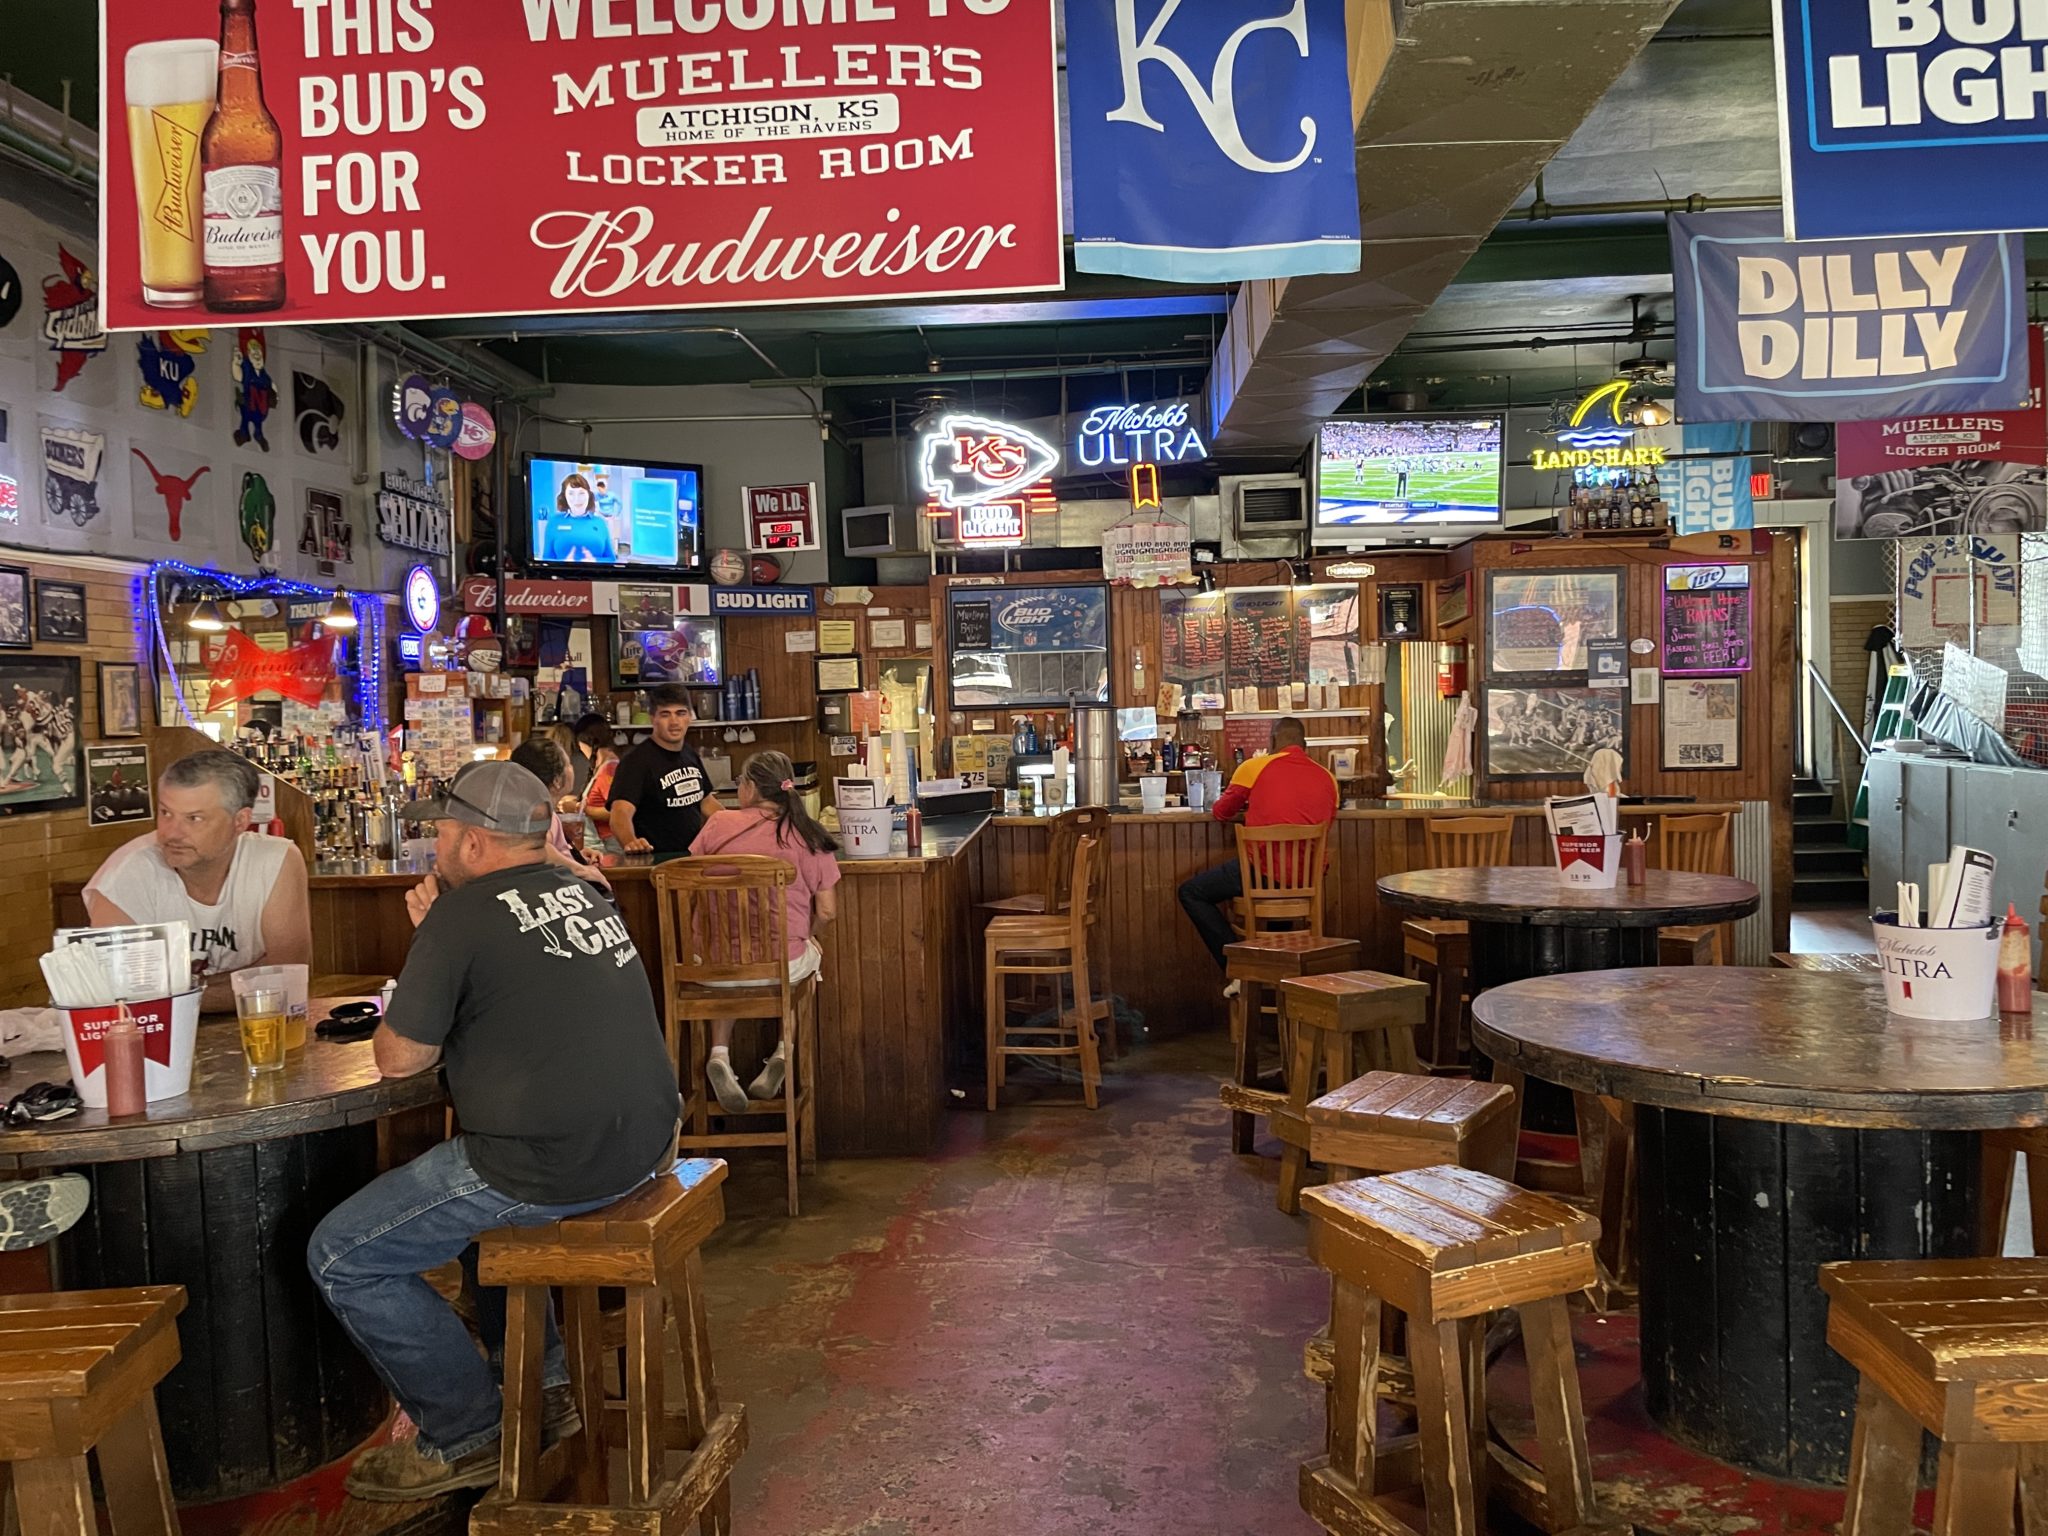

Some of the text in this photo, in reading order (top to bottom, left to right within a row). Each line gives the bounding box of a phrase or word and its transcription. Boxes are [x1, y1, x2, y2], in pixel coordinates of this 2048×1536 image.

[293, 0, 435, 58] THIS
[552, 44, 983, 115] MUELLER'S
[1106, 0, 1316, 173] KC
[299, 65, 486, 138] BUD'S
[659, 99, 879, 129] ATCHISON, KS
[666, 120, 872, 141] HOME OF THE RAVENS
[566, 128, 974, 186] LOCKER ROOM
[162, 123, 185, 232] Budweiser
[302, 150, 422, 216] FOR
[206, 225, 282, 244] Budweiser
[300, 229, 446, 294] YOU.
[529, 205, 1017, 299] Budweiser
[1737, 246, 1968, 315] DILLY
[1737, 310, 1968, 380] DILLY
[160, 359, 180, 381] KU
[1882, 417, 2004, 436] MUELLER'S
[1078, 427, 1208, 466] ULTRA
[1885, 441, 2001, 456] LOCKER ROOM
[1532, 447, 1665, 470] LANDSHARK
[385, 473, 409, 494] BUD
[1711, 459, 1735, 530] BUD
[755, 493, 804, 513] We I.D.
[971, 505, 1012, 520] BUD
[380, 491, 449, 556] SELTZER
[963, 519, 1021, 537] LIGHT
[787, 536, 797, 547] 12
[716, 593, 809, 609] BUD LIGHT
[1014, 607, 1052, 615] BUD
[1005, 614, 1055, 624] LIGHT
[1686, 608, 1729, 624] RAVENS
[403, 640, 420, 655] BU
[496, 884, 594, 933] LAST
[1879, 936, 1937, 956] Michelob
[83, 1014, 159, 1031] SUPOR
